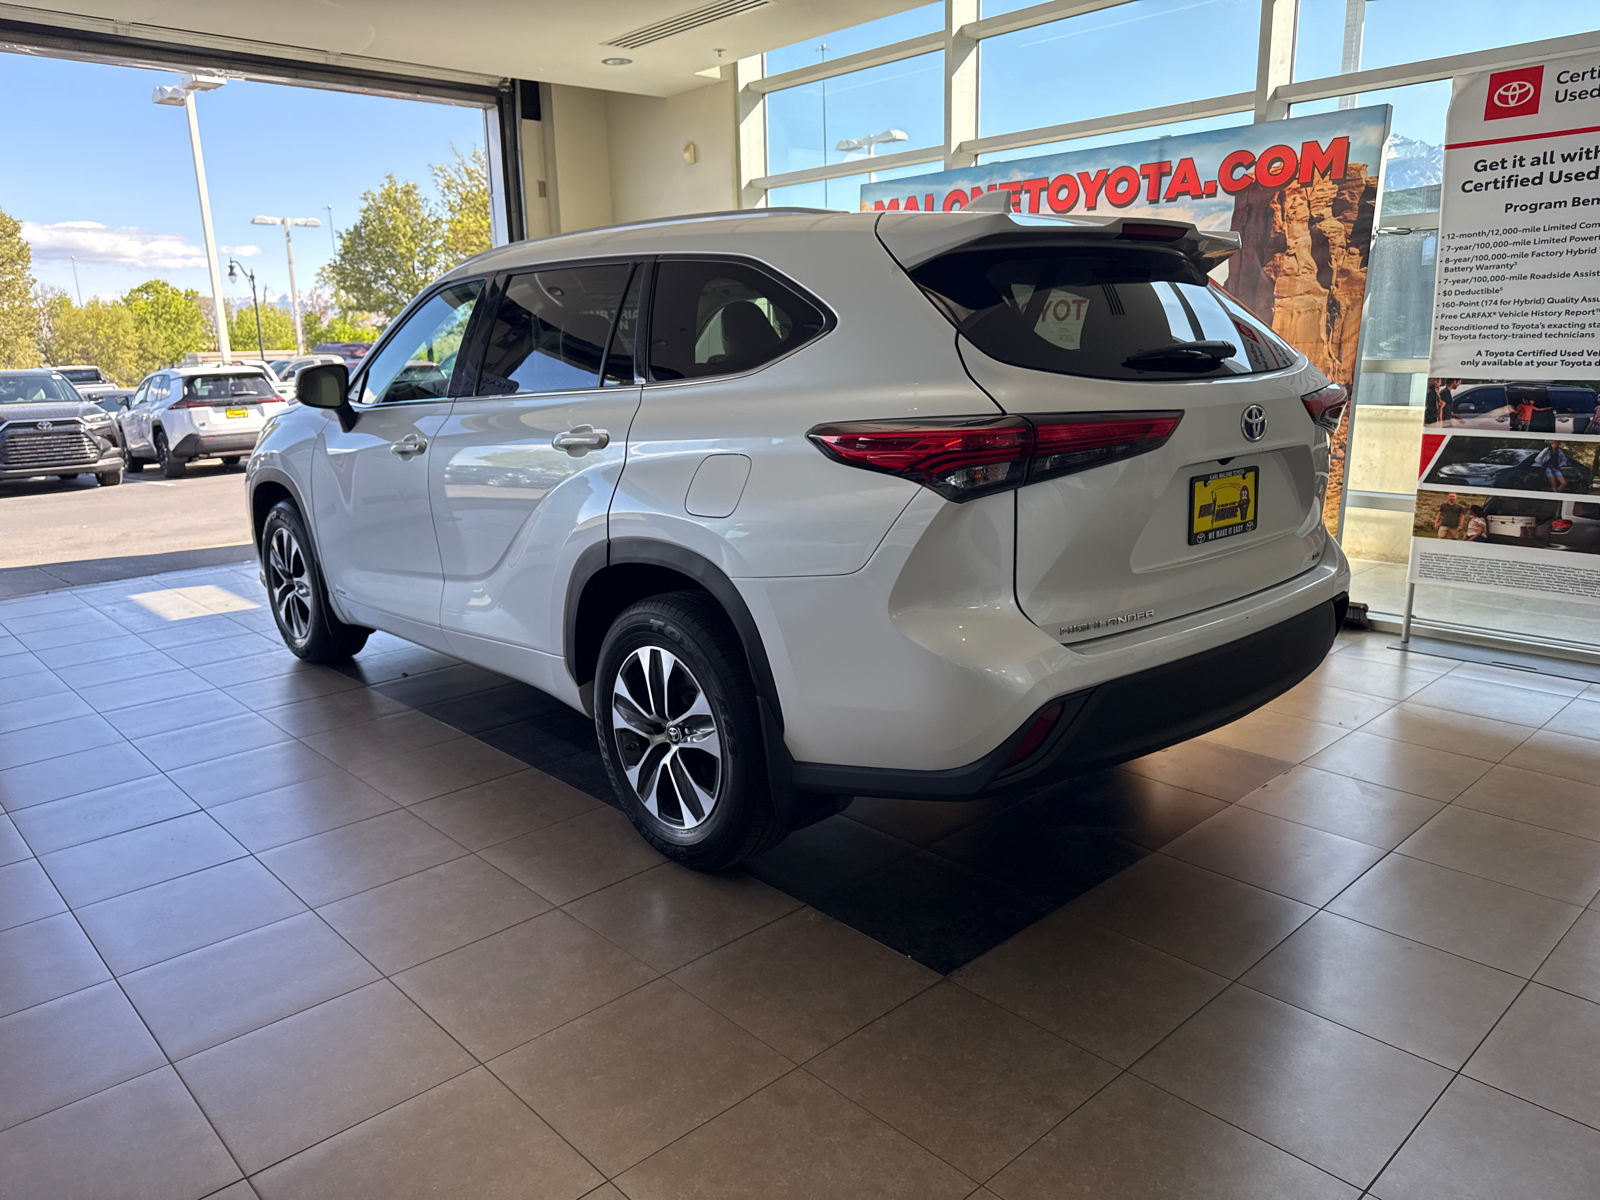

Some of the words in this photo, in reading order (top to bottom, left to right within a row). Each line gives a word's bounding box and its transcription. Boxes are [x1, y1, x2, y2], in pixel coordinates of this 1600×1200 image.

[1556, 65, 1600, 85] Certi
[1554, 83, 1600, 103] Used
[1473, 157, 1508, 173] Get
[1512, 155, 1526, 169] it
[1530, 150, 1555, 167] all
[1560, 145, 1600, 163] with
[874, 136, 1350, 213] OETOYOTA.COM
[1461, 171, 1544, 194] Certified
[1549, 165, 1600, 184] Used
[1504, 200, 1567, 214] Program
[1446, 225, 1541, 240] 12-month/12,000-mile
[1543, 222, 1577, 233] Limited
[1445, 239, 1531, 253] 7-year/100,000-mile
[1533, 236, 1567, 246] Limited
[1444, 251, 1530, 265] 8-year/100,000-mile
[1531, 249, 1564, 260] Factory
[1566, 246, 1597, 257] Hybrid
[1443, 273, 1528, 286] 7-year/100,000-mile
[1529, 271, 1571, 281] Roadside
[1572, 269, 1600, 279] Assist
[1444, 265, 1474, 275] Battery
[1442, 289, 1453, 298] $0
[1441, 301, 1480, 309] 160-Point
[1481, 299, 1498, 308] (174
[1500, 298, 1512, 306] for
[1513, 297, 1545, 308] Hybrid)
[1546, 296, 1579, 306] Quality
[1440, 312, 1458, 320] Free
[1498, 310, 1529, 319] Vehicle
[1531, 309, 1563, 319] History
[1439, 322, 1499, 332] Reconditioned
[1500, 323, 1510, 331] to
[1511, 322, 1546, 332] Toyota's
[1547, 321, 1586, 331] exacting
[1438, 333, 1448, 342] by
[1450, 333, 1477, 342] Toyota
[1478, 331, 1543, 342] factory-trained
[1544, 331, 1596, 340] technicians
[1475, 350, 1483, 358] A
[1484, 349, 1515, 358] Toyota
[1516, 349, 1558, 358] Certified
[1559, 349, 1585, 358] Used
[1460, 359, 1480, 368] only
[1481, 358, 1523, 368] available
[1524, 359, 1535, 367] at
[1536, 361, 1558, 369] your
[1560, 359, 1592, 369] Toyota
[1209, 531, 1215, 539] WE
[1216, 528, 1228, 539] MAKE
[1233, 525, 1243, 535] EASY
[1059, 609, 1155, 636] HIGHLANDER
